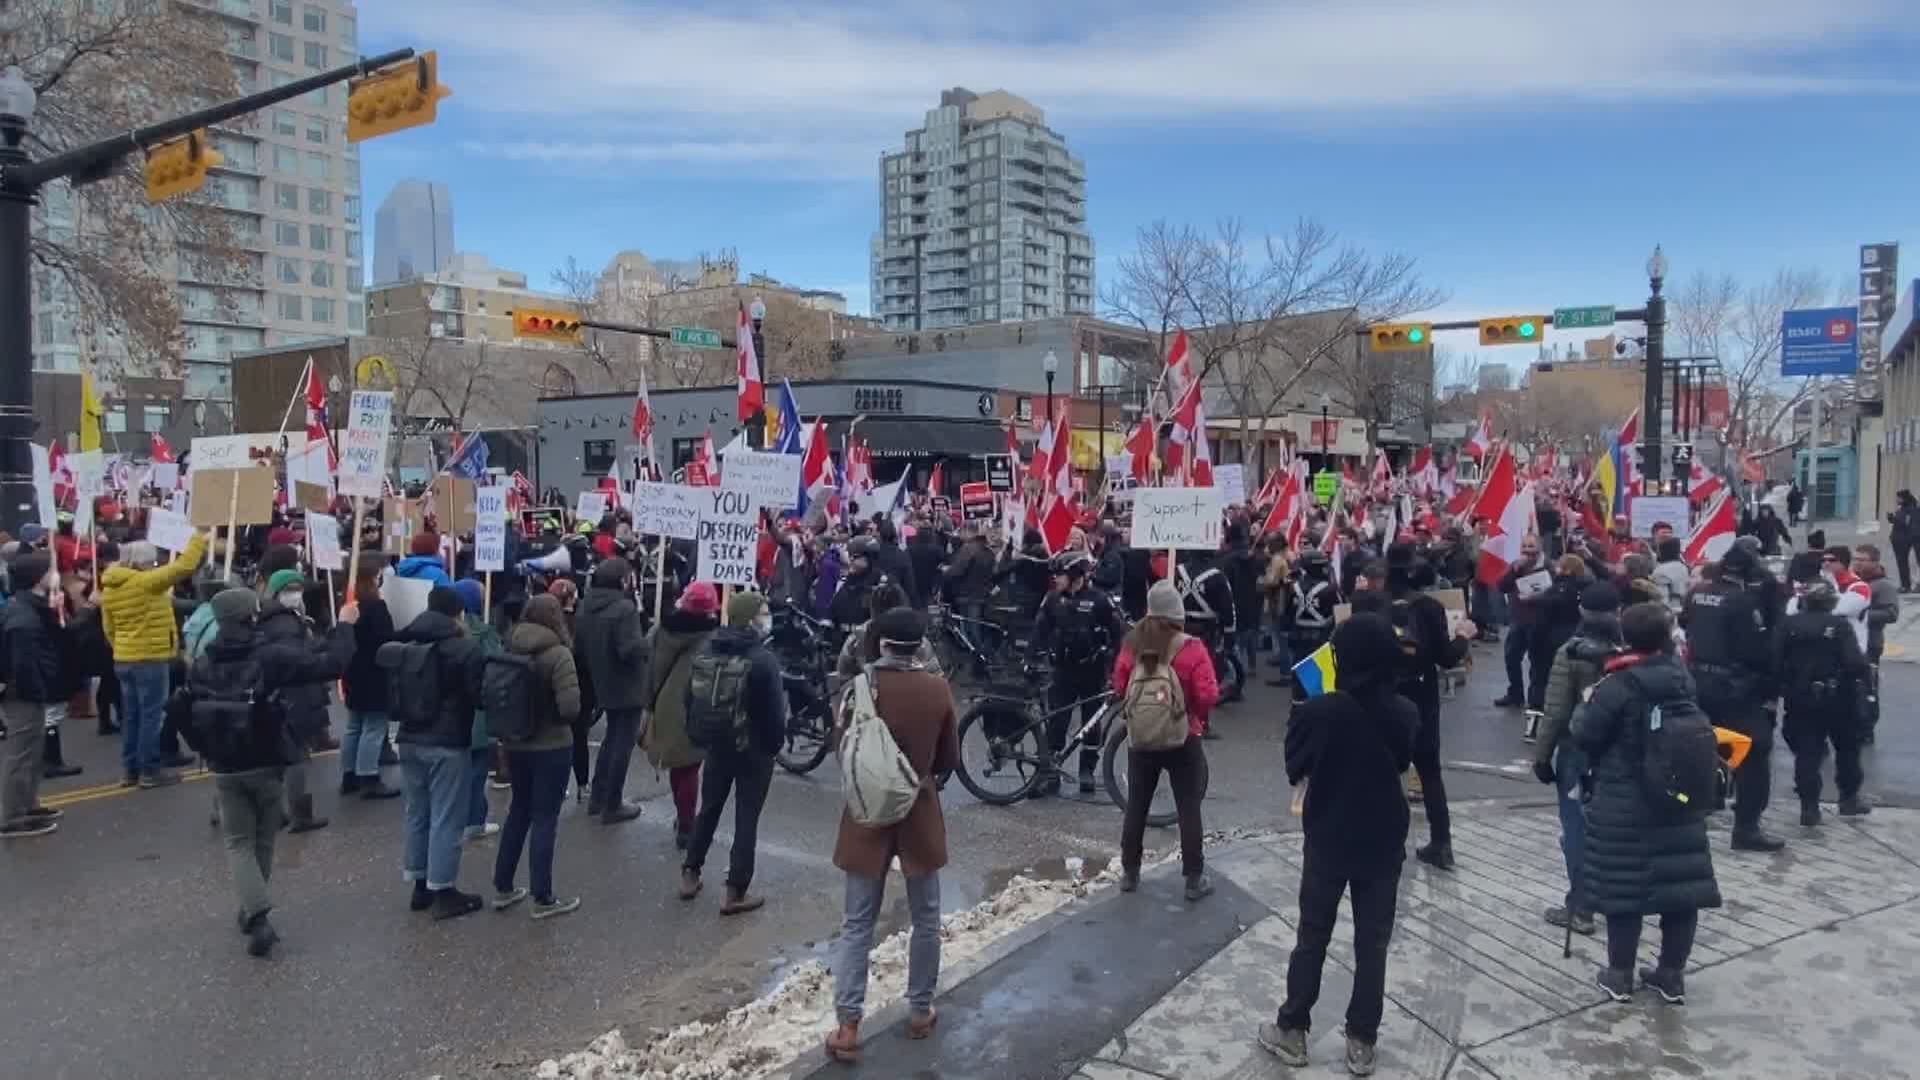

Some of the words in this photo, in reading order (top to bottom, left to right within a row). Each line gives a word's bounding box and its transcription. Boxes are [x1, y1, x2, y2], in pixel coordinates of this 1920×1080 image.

[1787, 326, 1821, 339] BMO
[855, 387, 903, 399] ANALOG
[855, 399, 903, 411] COFFEE
[712, 491, 750, 514] YOU
[1143, 494, 1207, 521] Support
[700, 521, 758, 542] DESERVE
[710, 543, 748, 560] SICK
[713, 563, 753, 582] DAYS
